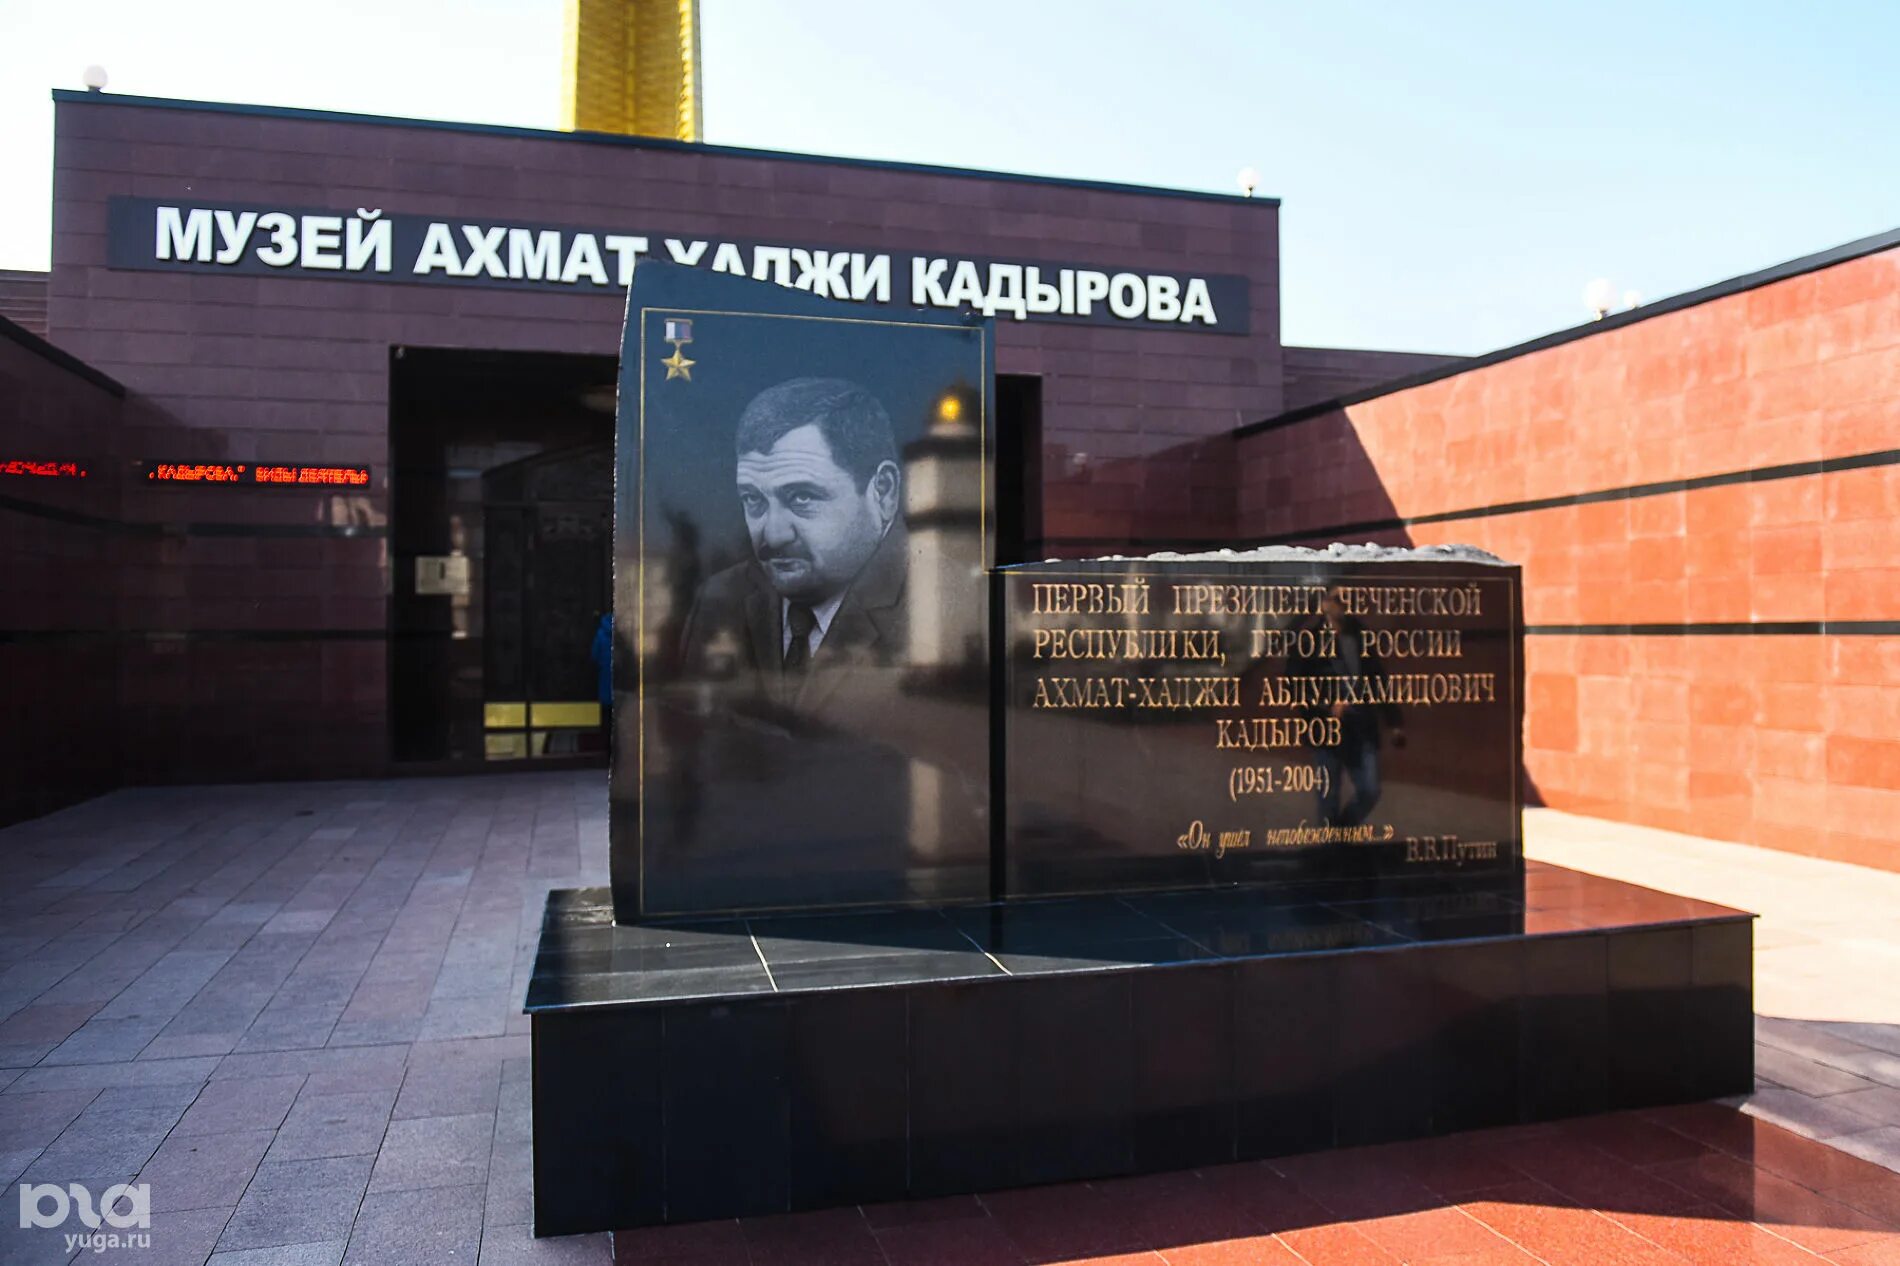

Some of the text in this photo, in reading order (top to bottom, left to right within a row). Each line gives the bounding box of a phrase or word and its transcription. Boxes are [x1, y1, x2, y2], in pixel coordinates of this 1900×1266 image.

[155, 206, 393, 272] МУЗЕЙ
[412, 222, 649, 286] АХМАТ
[911, 256, 1217, 325] КАДЫРОВА
[1032, 577, 1482, 618] ПЕРВЫЙ ПРЕЗИДЕНТ ЧЕЧЕНСКОЙ
[1032, 623, 1463, 666] РЕСПУБЛИКИ, ГЕРОЙ РОССИИ
[1032, 672, 1496, 711] АХМАТ-ХАДЖИ АБДУЛХАМИДОВИЧ
[1215, 716, 1341, 750] КАДЫРОВ
[1229, 764, 1331, 803] (1951-2004)
[1176, 820, 1212, 850] «Он
